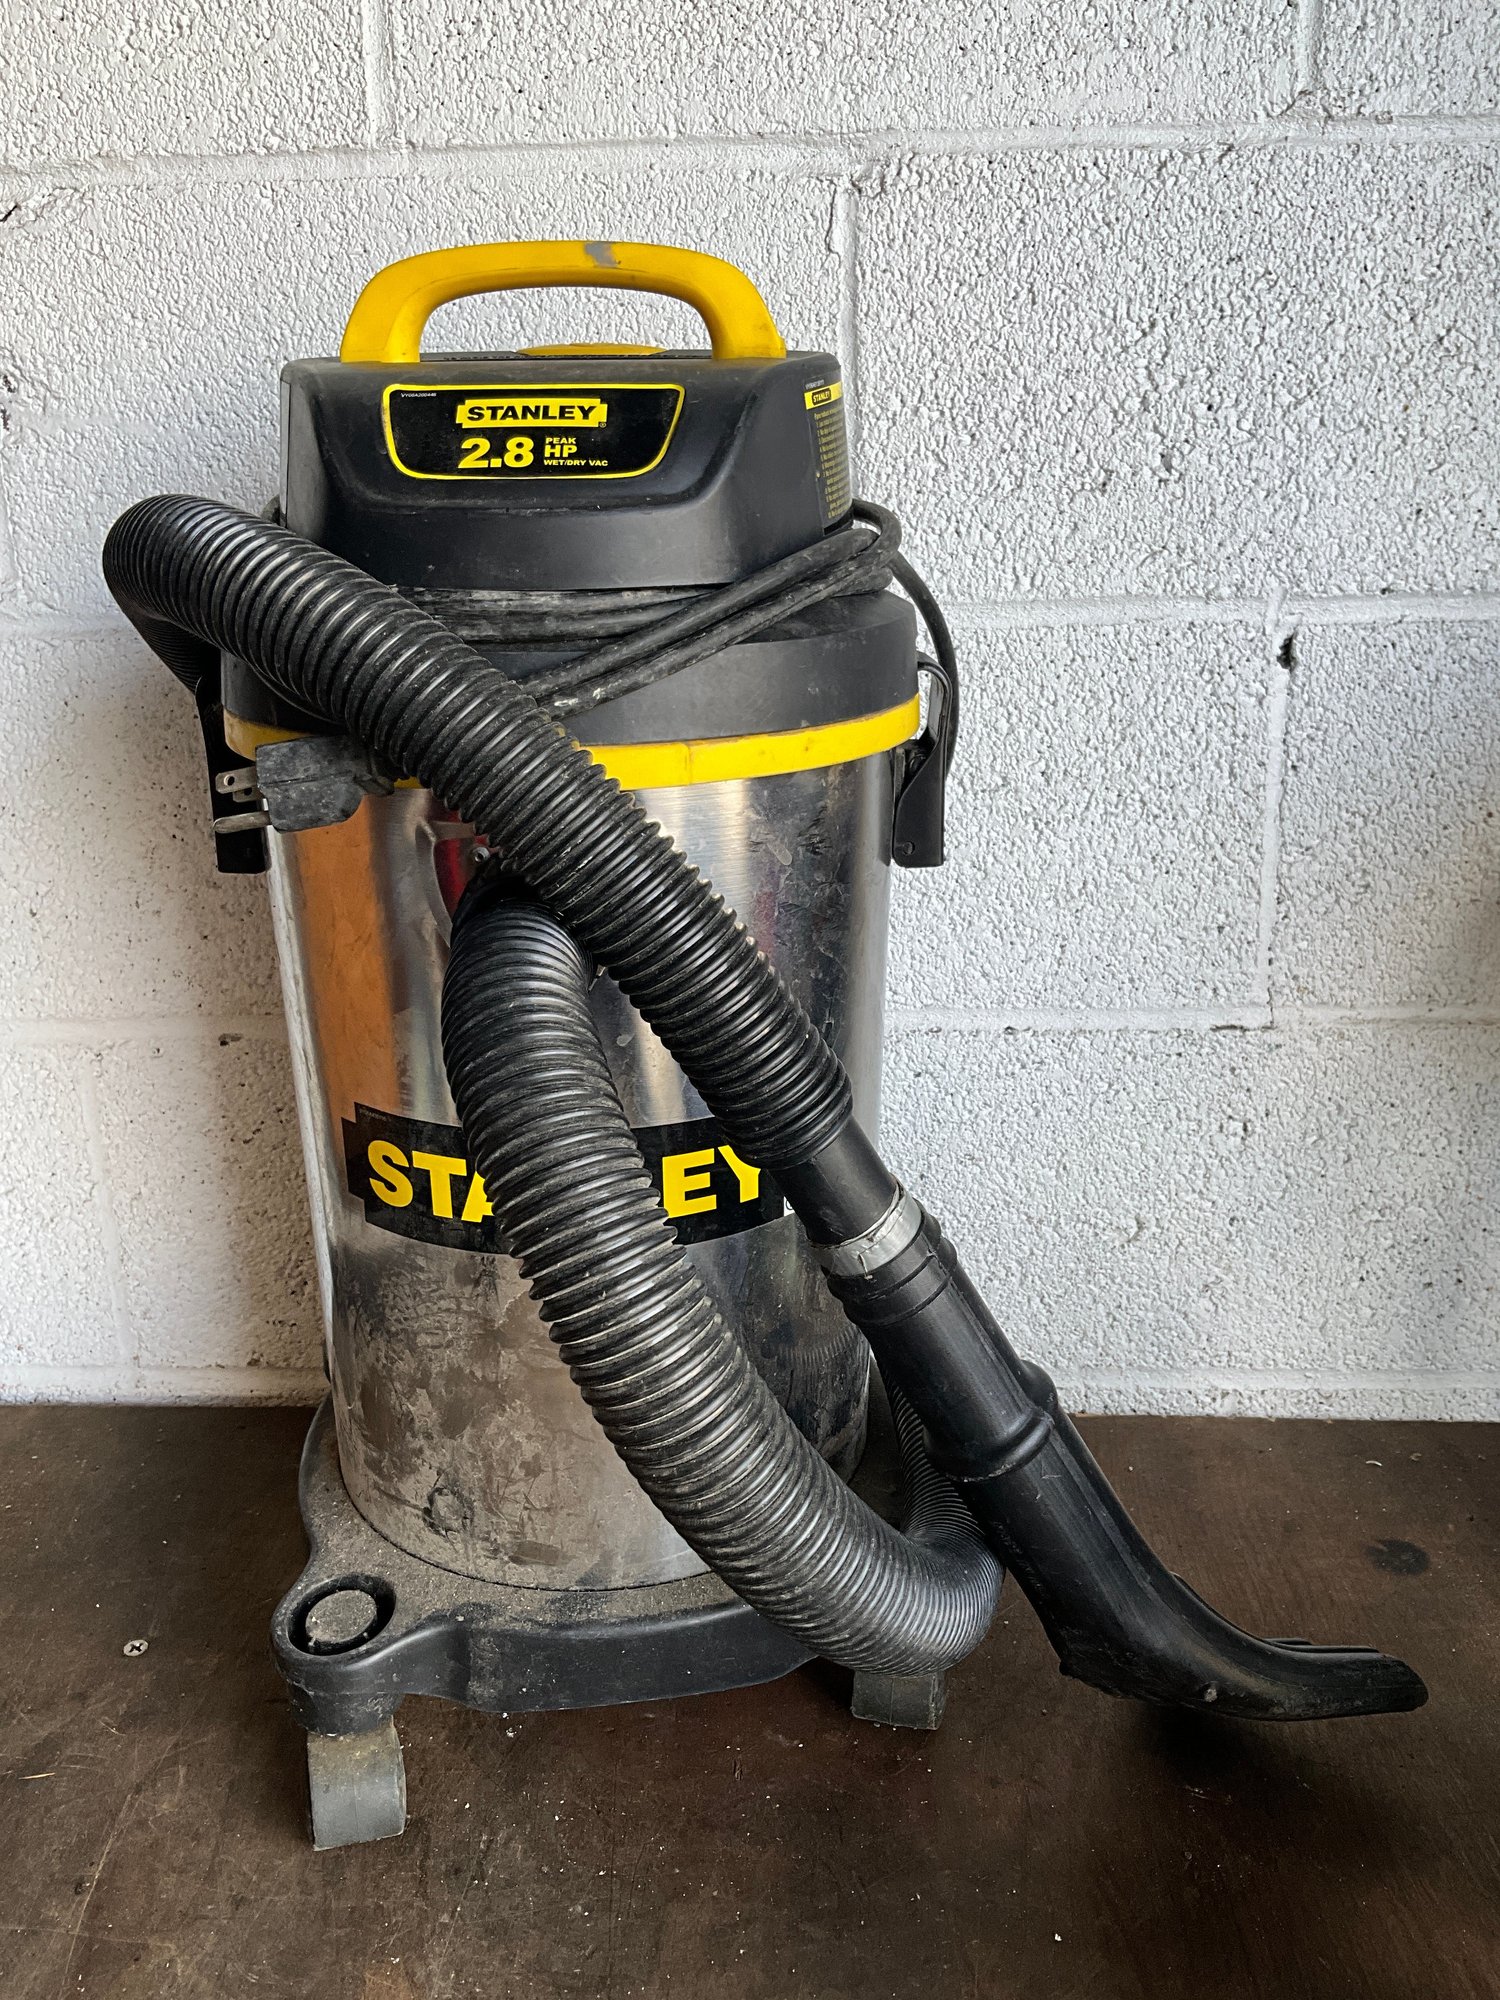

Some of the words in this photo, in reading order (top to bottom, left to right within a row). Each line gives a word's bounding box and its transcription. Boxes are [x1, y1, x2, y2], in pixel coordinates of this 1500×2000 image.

[467, 405, 597, 421] STANLEY
[457, 436, 534, 469] 2.8
[544, 445, 578, 458] HP
[588, 459, 609, 467] VAC
[367, 1140, 761, 1222] STAEY
